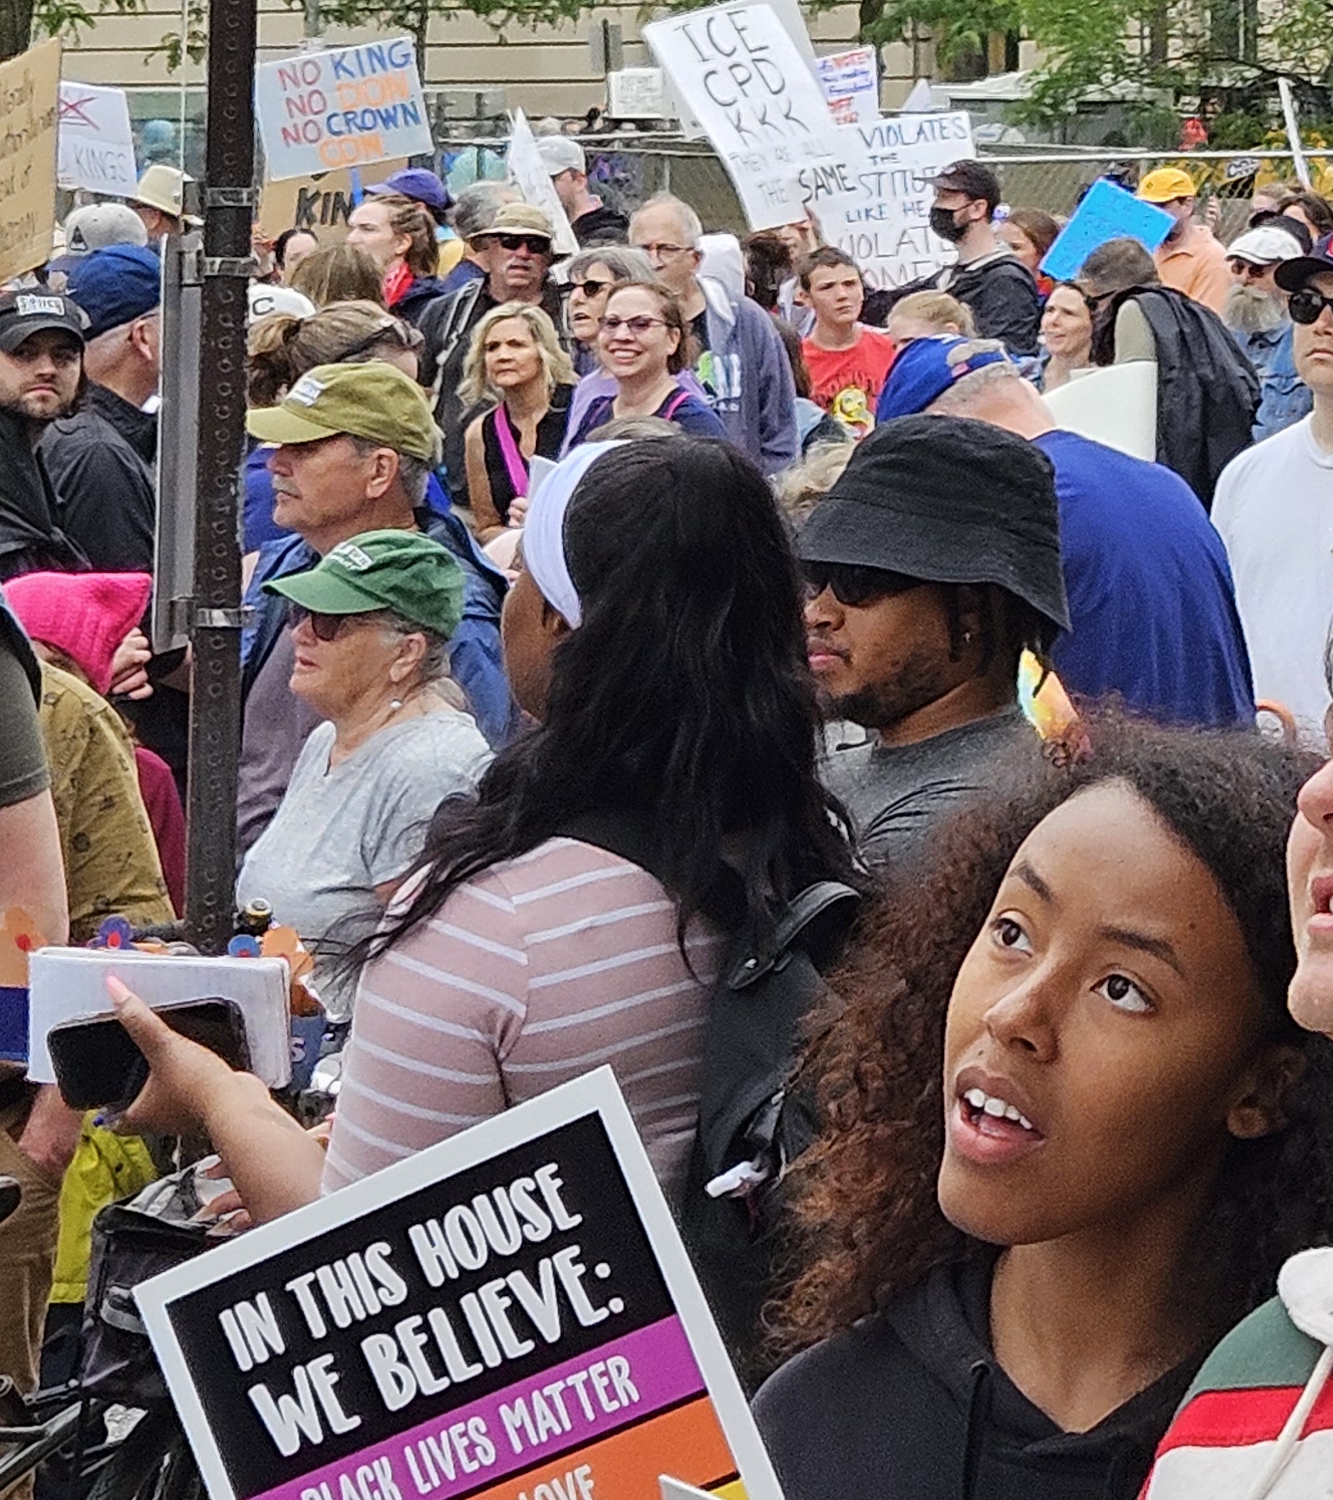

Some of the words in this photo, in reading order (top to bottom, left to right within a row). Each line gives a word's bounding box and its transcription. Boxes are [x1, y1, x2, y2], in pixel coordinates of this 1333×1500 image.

[674, 9, 769, 63] ICE
[277, 60, 322, 92] NO
[331, 40, 414, 80] KING
[702, 57, 786, 107] CPD
[279, 119, 323, 149] NO
[326, 100, 423, 137] CROWN
[285, 88, 328, 119] NO
[724, 99, 810, 148] KKK
[857, 116, 969, 149] VIOLATES
[72, 150, 130, 184] KINGS
[797, 162, 858, 206] SAME
[252, 296, 275, 316] C
[218, 1290, 287, 1373] IN
[285, 1240, 410, 1340] THIS
[407, 1162, 584, 1288] HOUSE
[247, 1353, 361, 1458] WE
[360, 1243, 626, 1413] BELIEVE:
[403, 1416, 497, 1496] LIVES
[498, 1354, 641, 1455] MATTER
